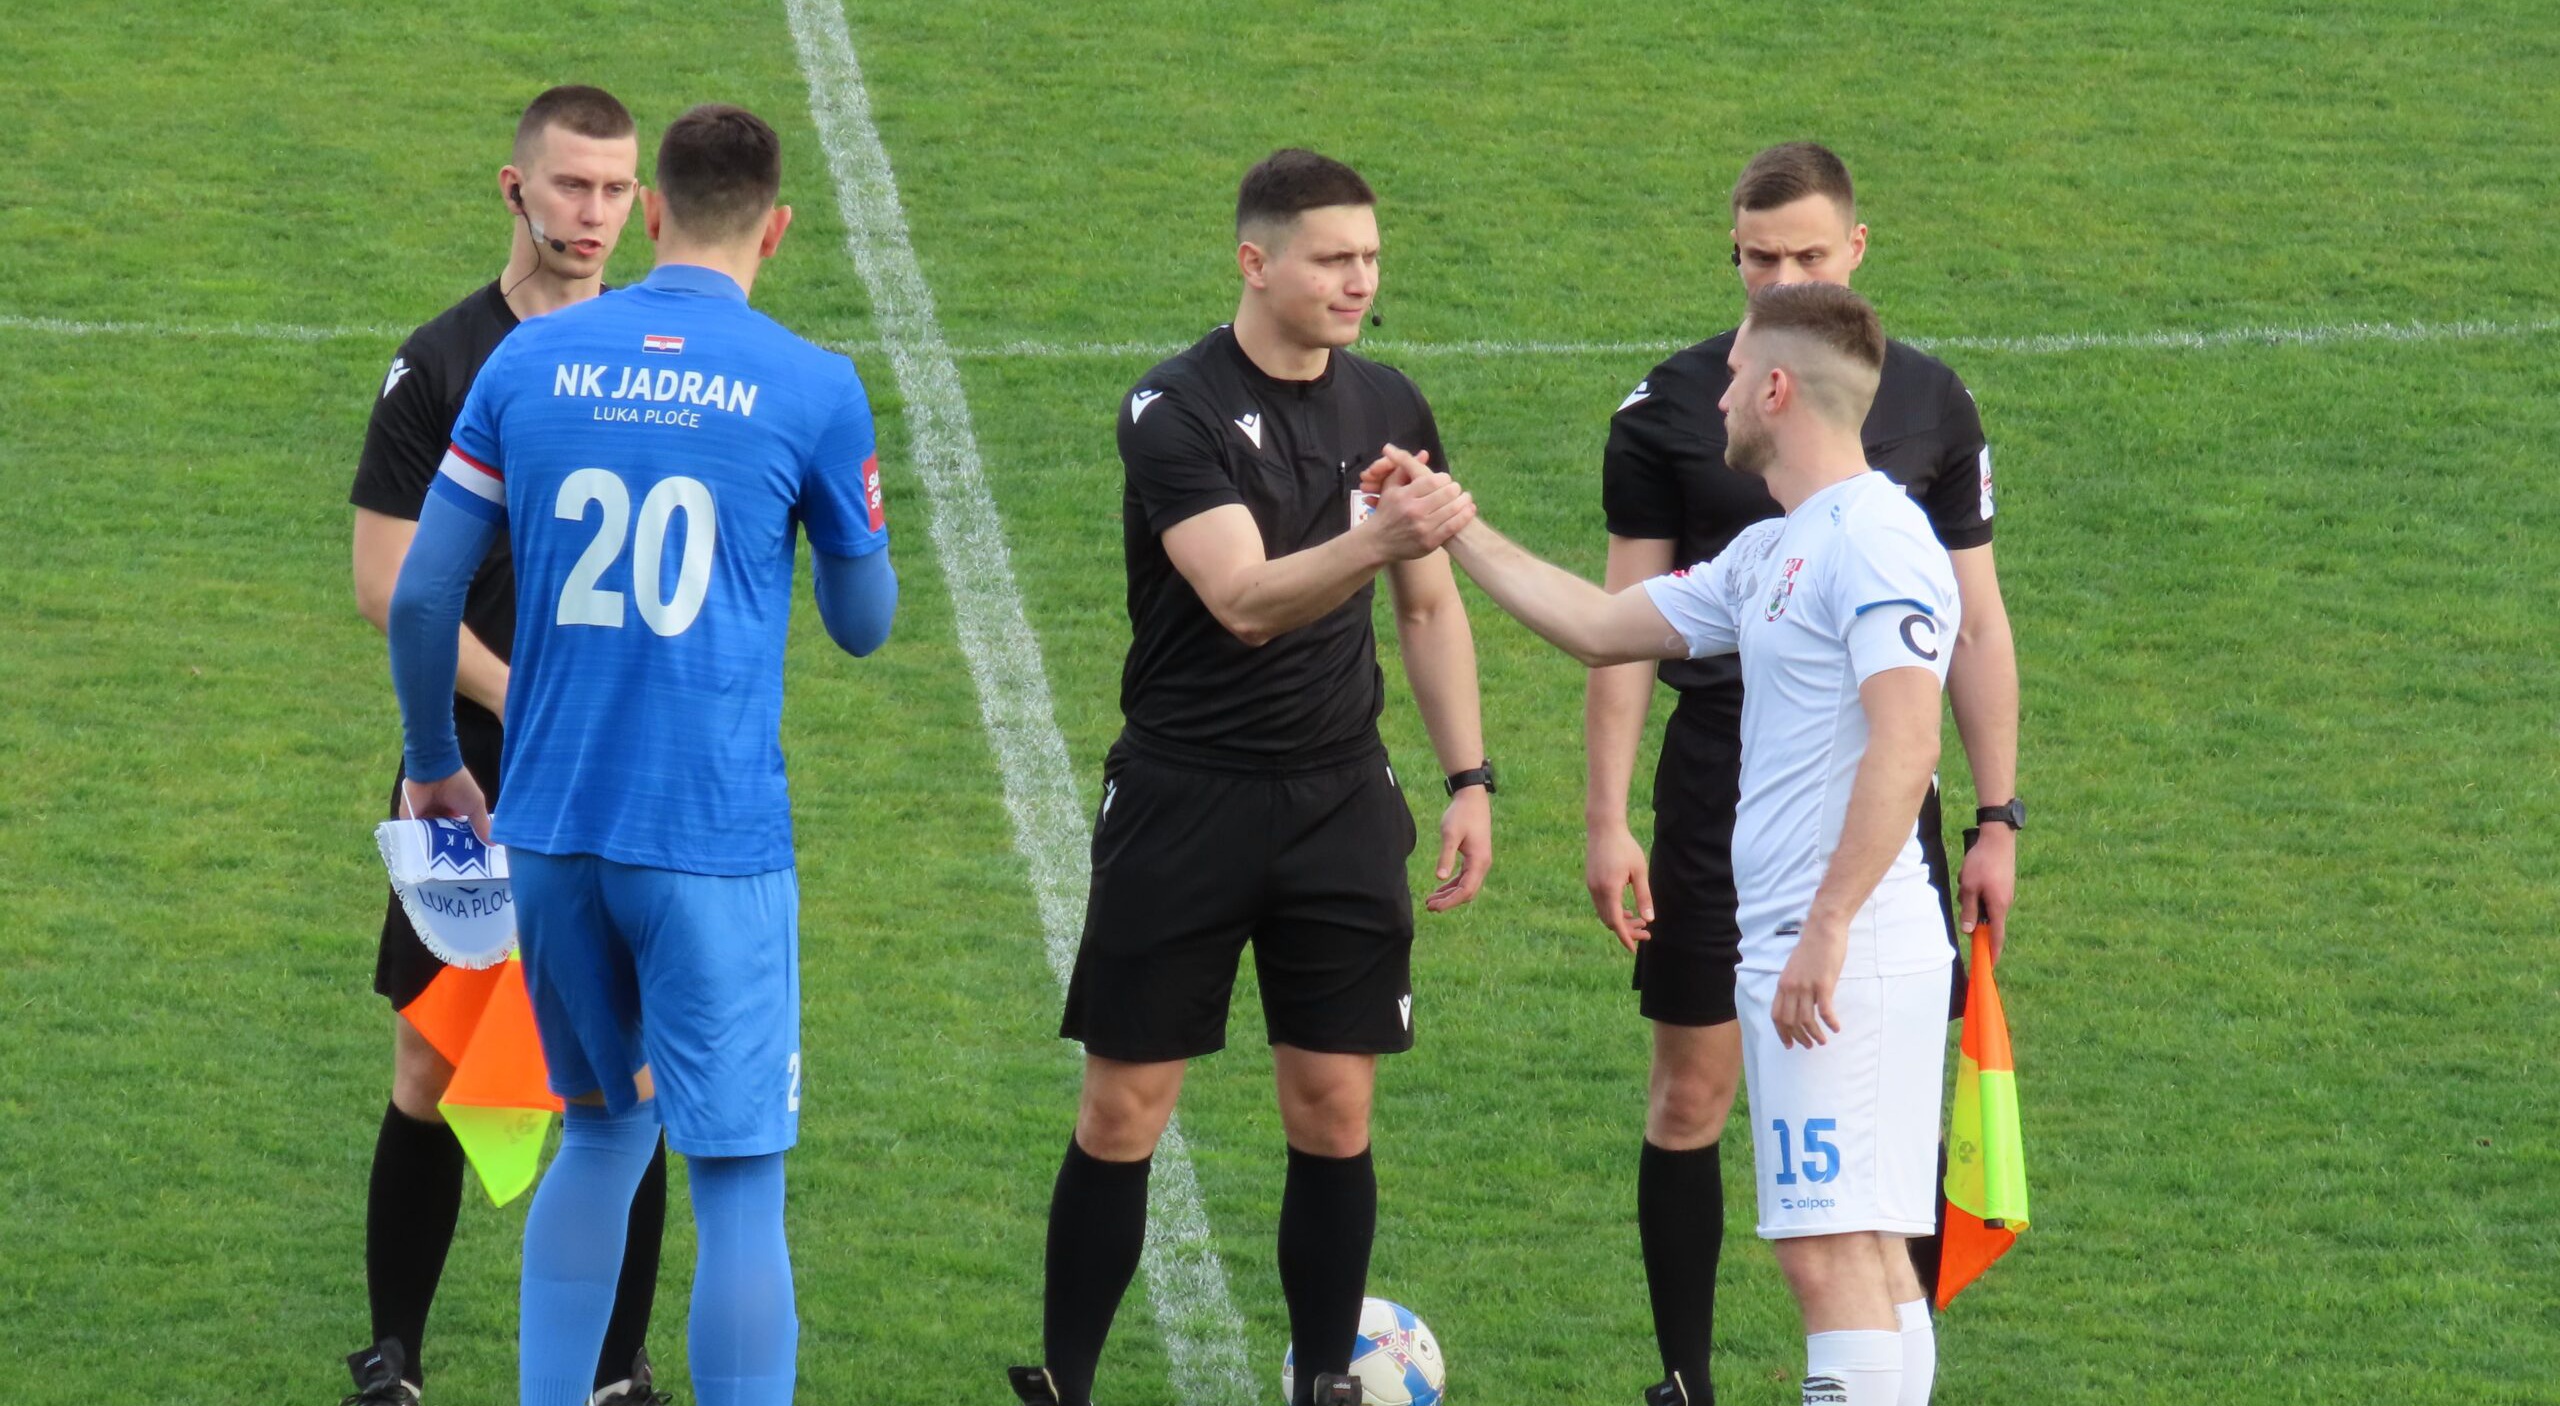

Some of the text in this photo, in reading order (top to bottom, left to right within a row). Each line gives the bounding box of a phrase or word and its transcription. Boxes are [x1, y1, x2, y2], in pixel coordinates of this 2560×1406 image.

[554, 364, 758, 417] NK JADRAN
[593, 406, 701, 428] LUKA PLOČE
[555, 468, 716, 637] 20
[1900, 614, 1938, 661] C
[417, 887, 469, 918] LUKA
[1772, 1118, 1840, 1186] 15
[1796, 1197, 1836, 1211] alpas
